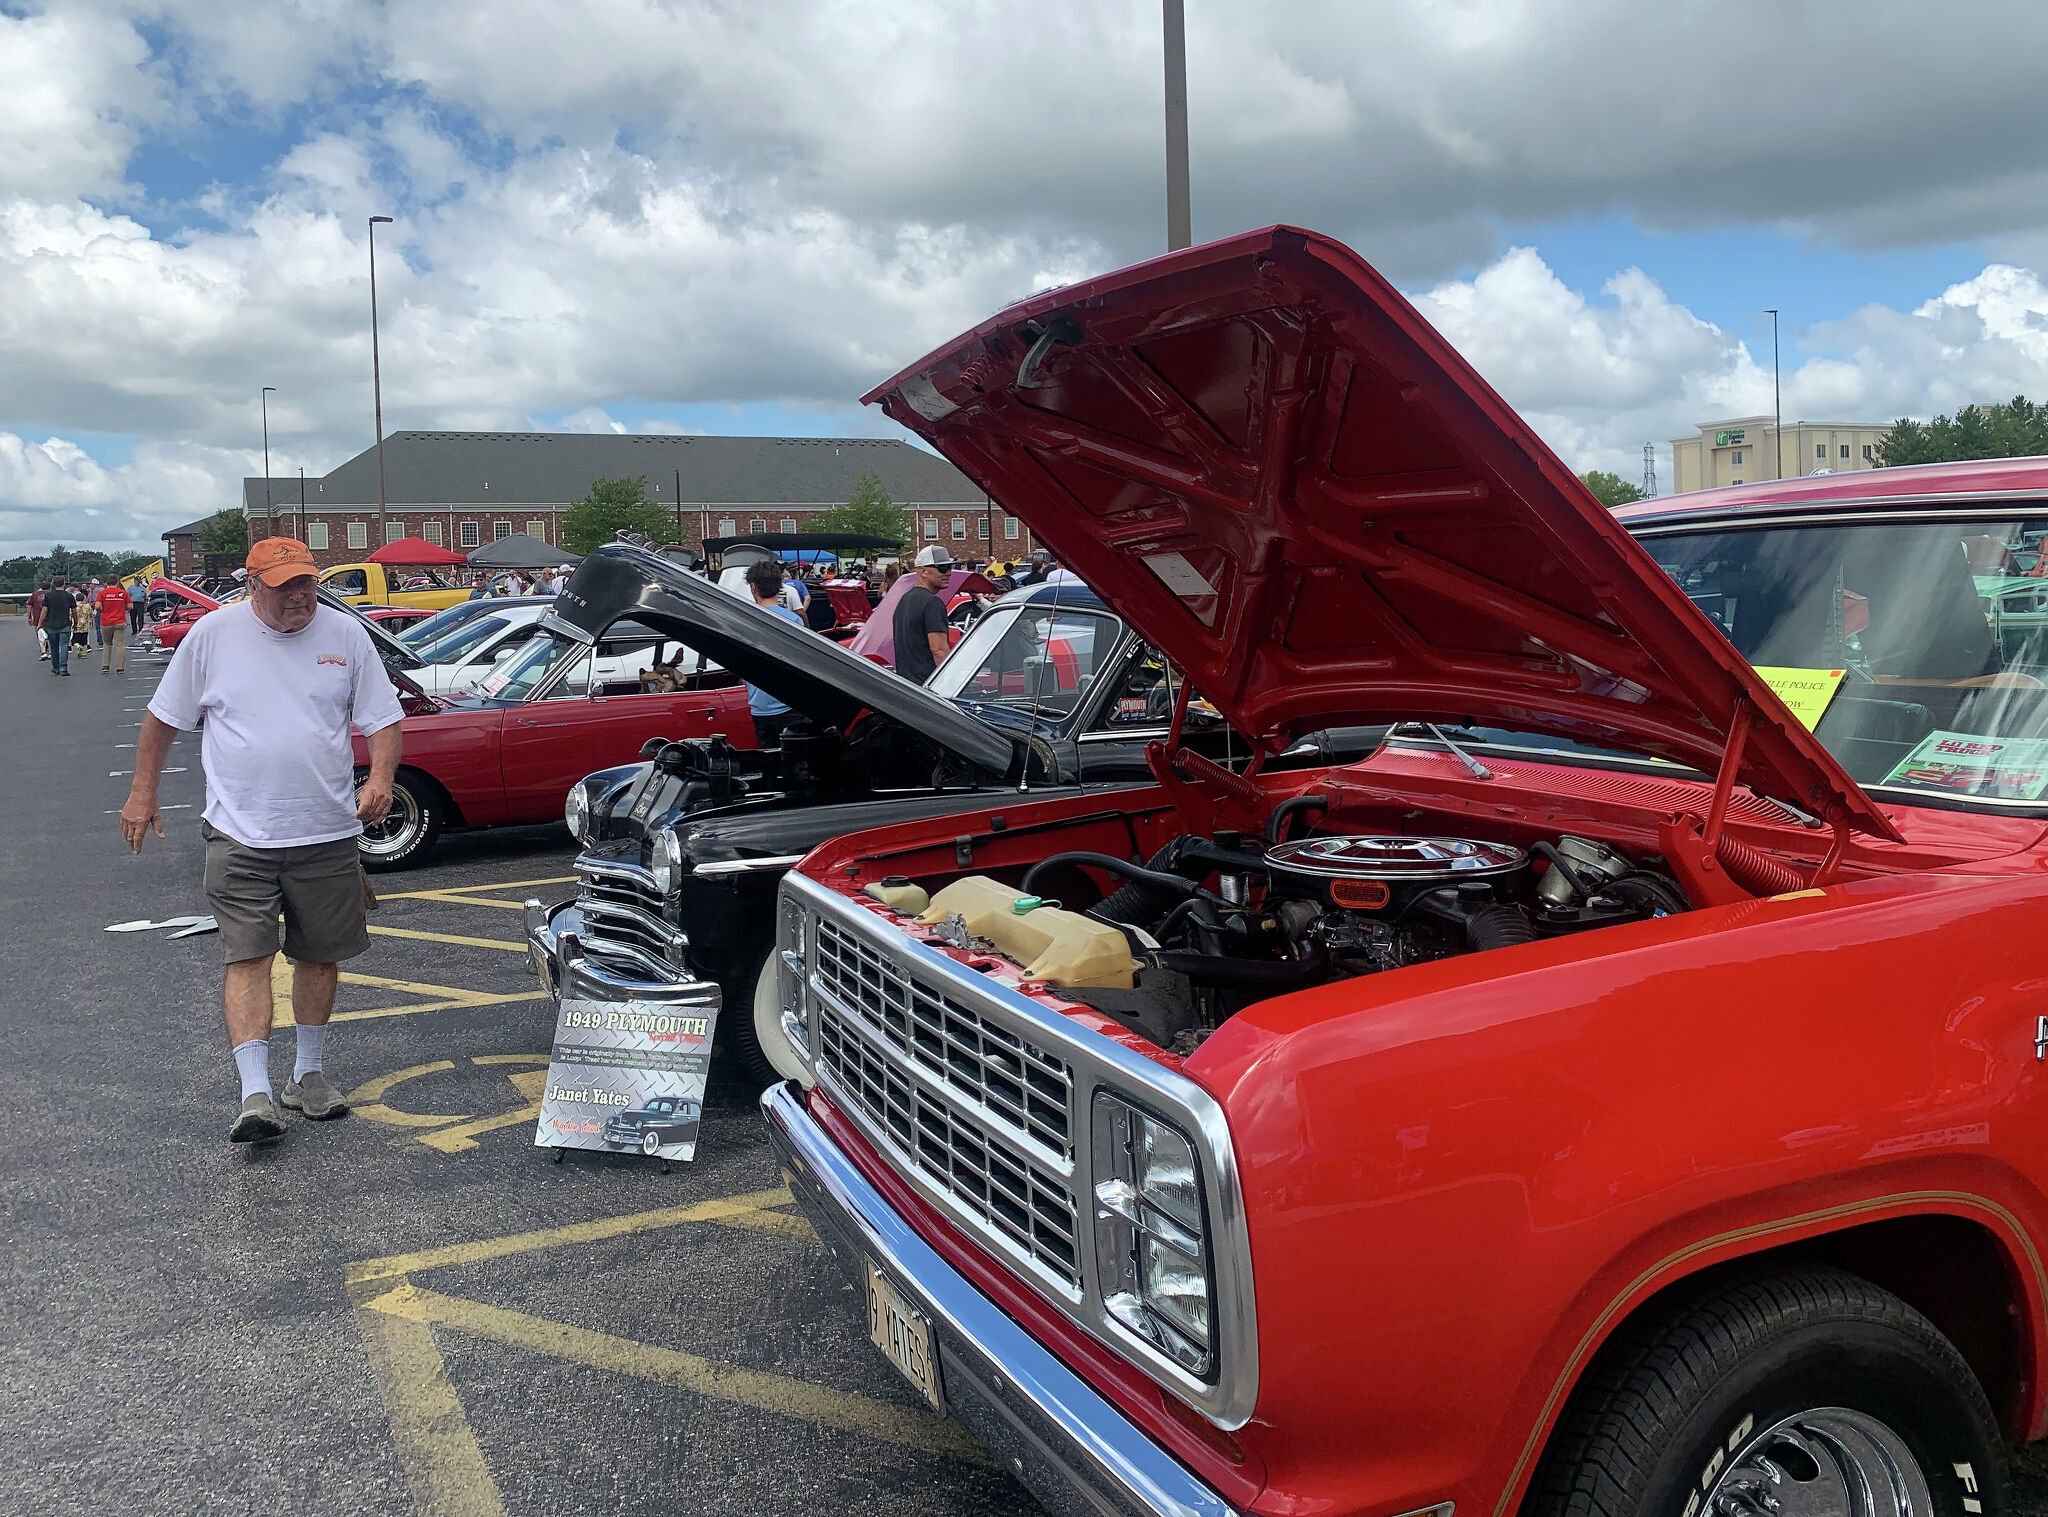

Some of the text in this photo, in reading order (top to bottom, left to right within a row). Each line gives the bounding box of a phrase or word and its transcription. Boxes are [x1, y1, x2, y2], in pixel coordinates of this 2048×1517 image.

[1790, 681, 1825, 690] POLICE
[564, 1011, 708, 1036] 1949 PLYMOUTH
[549, 1085, 630, 1106] Janet Yates
[883, 1300, 926, 1383] YATES
